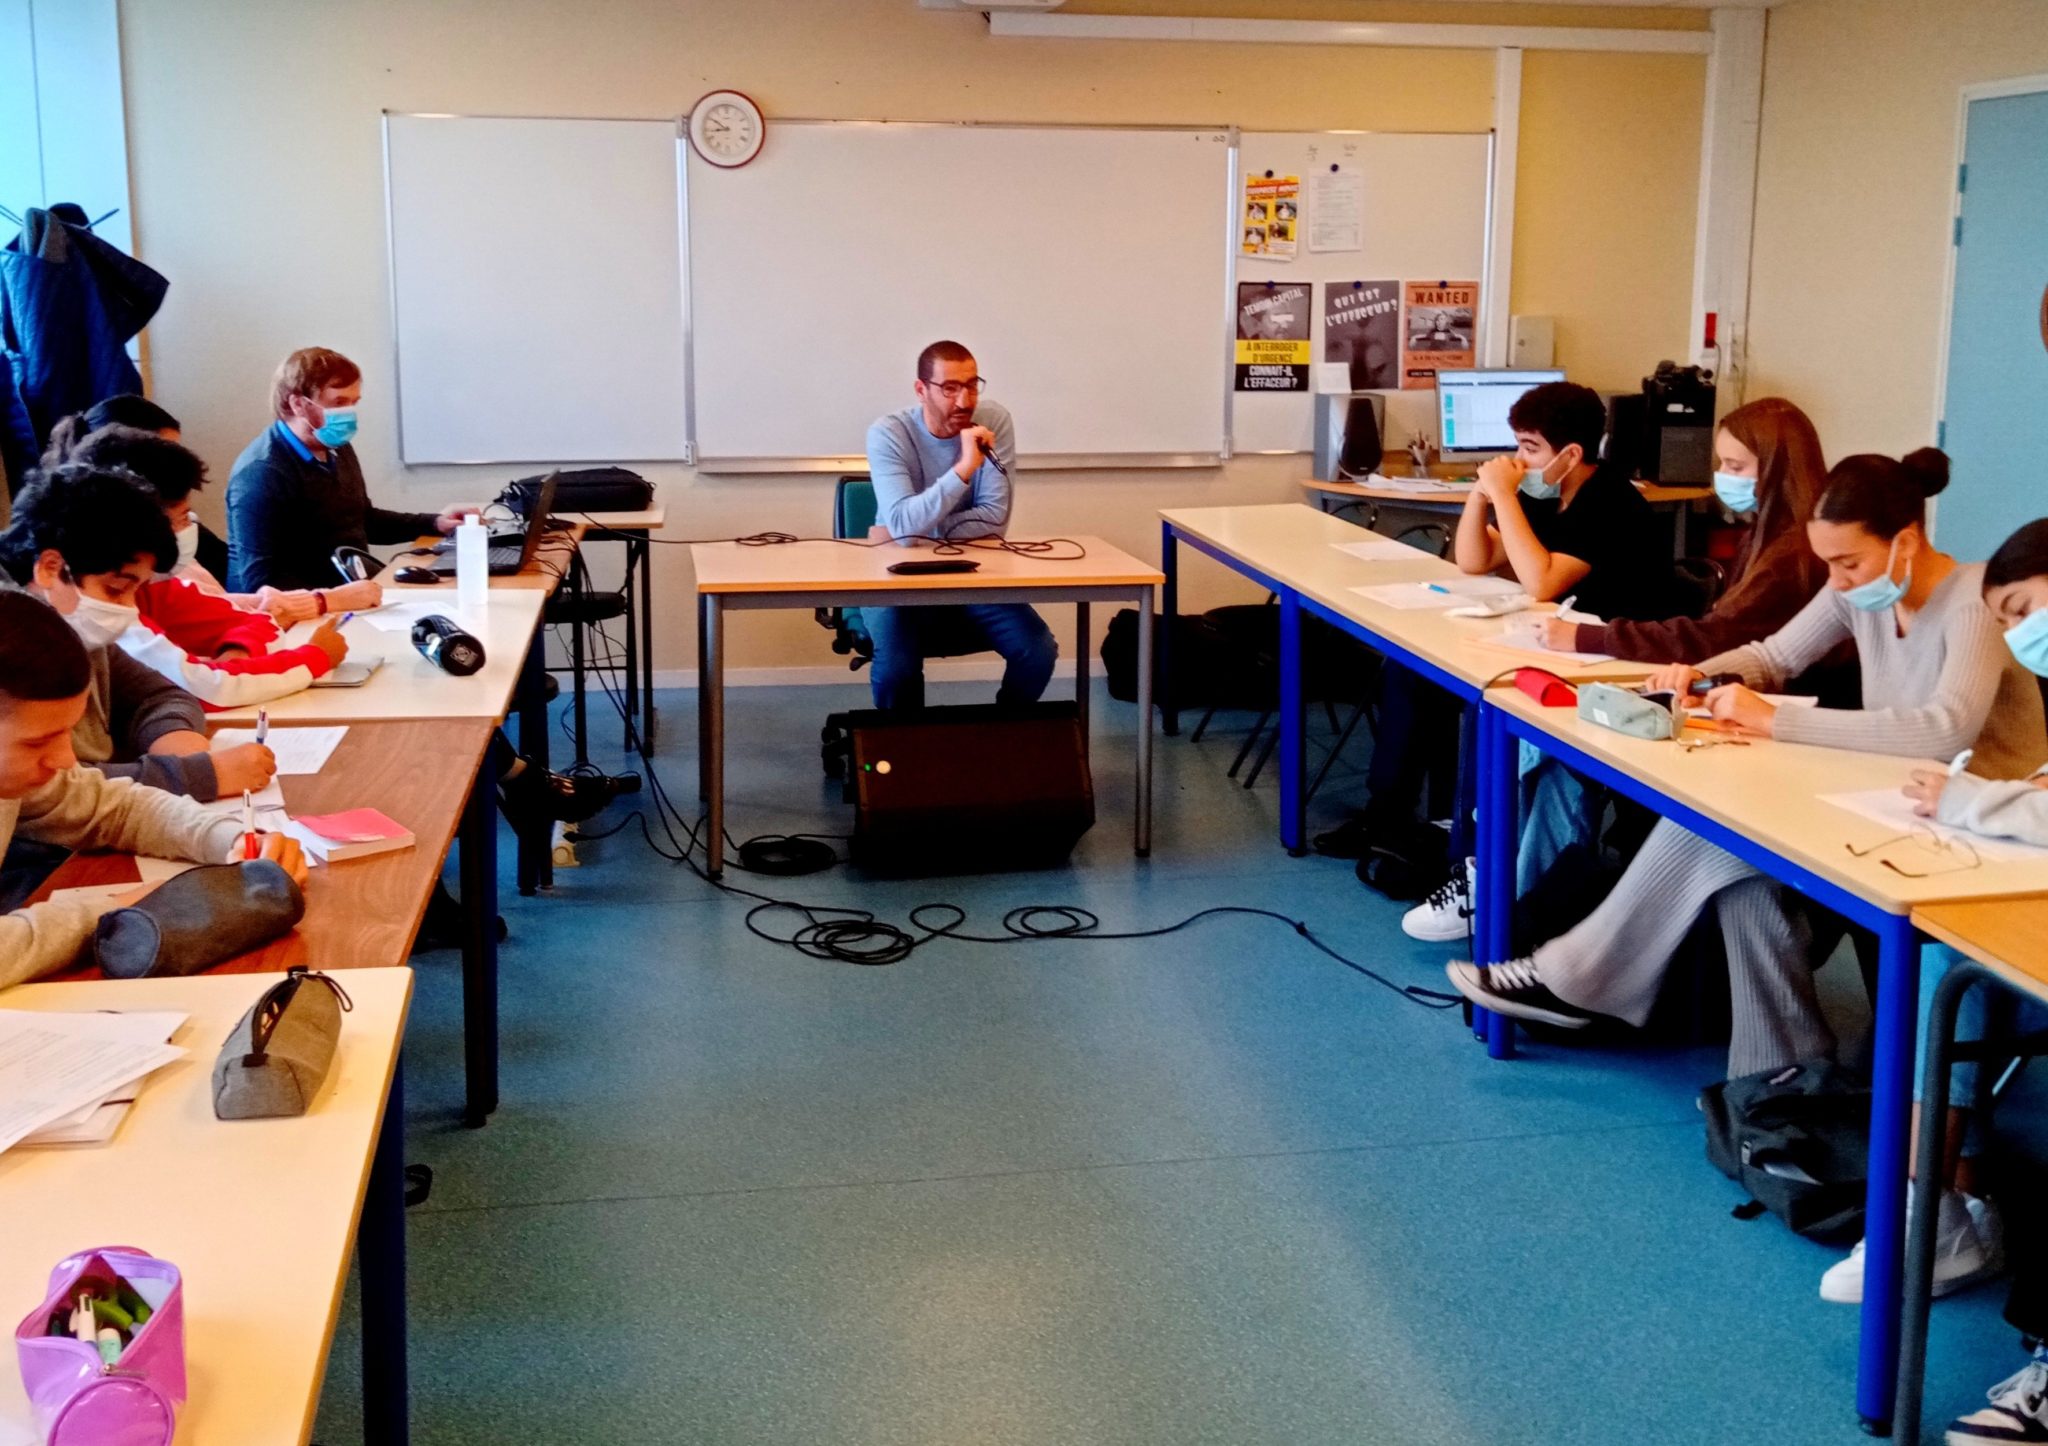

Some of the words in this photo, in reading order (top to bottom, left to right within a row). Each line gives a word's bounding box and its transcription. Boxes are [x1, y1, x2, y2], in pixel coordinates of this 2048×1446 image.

[1272, 287, 1304, 306] CAPITAL
[1334, 294, 1355, 309] QUI
[1358, 288, 1380, 302] EST
[1415, 291, 1469, 304] WANTED
[1253, 342, 1298, 351] INTERROGER
[1252, 353, 1293, 363] D'URGENCE
[1244, 377, 1291, 388] L'EFFACEUR
